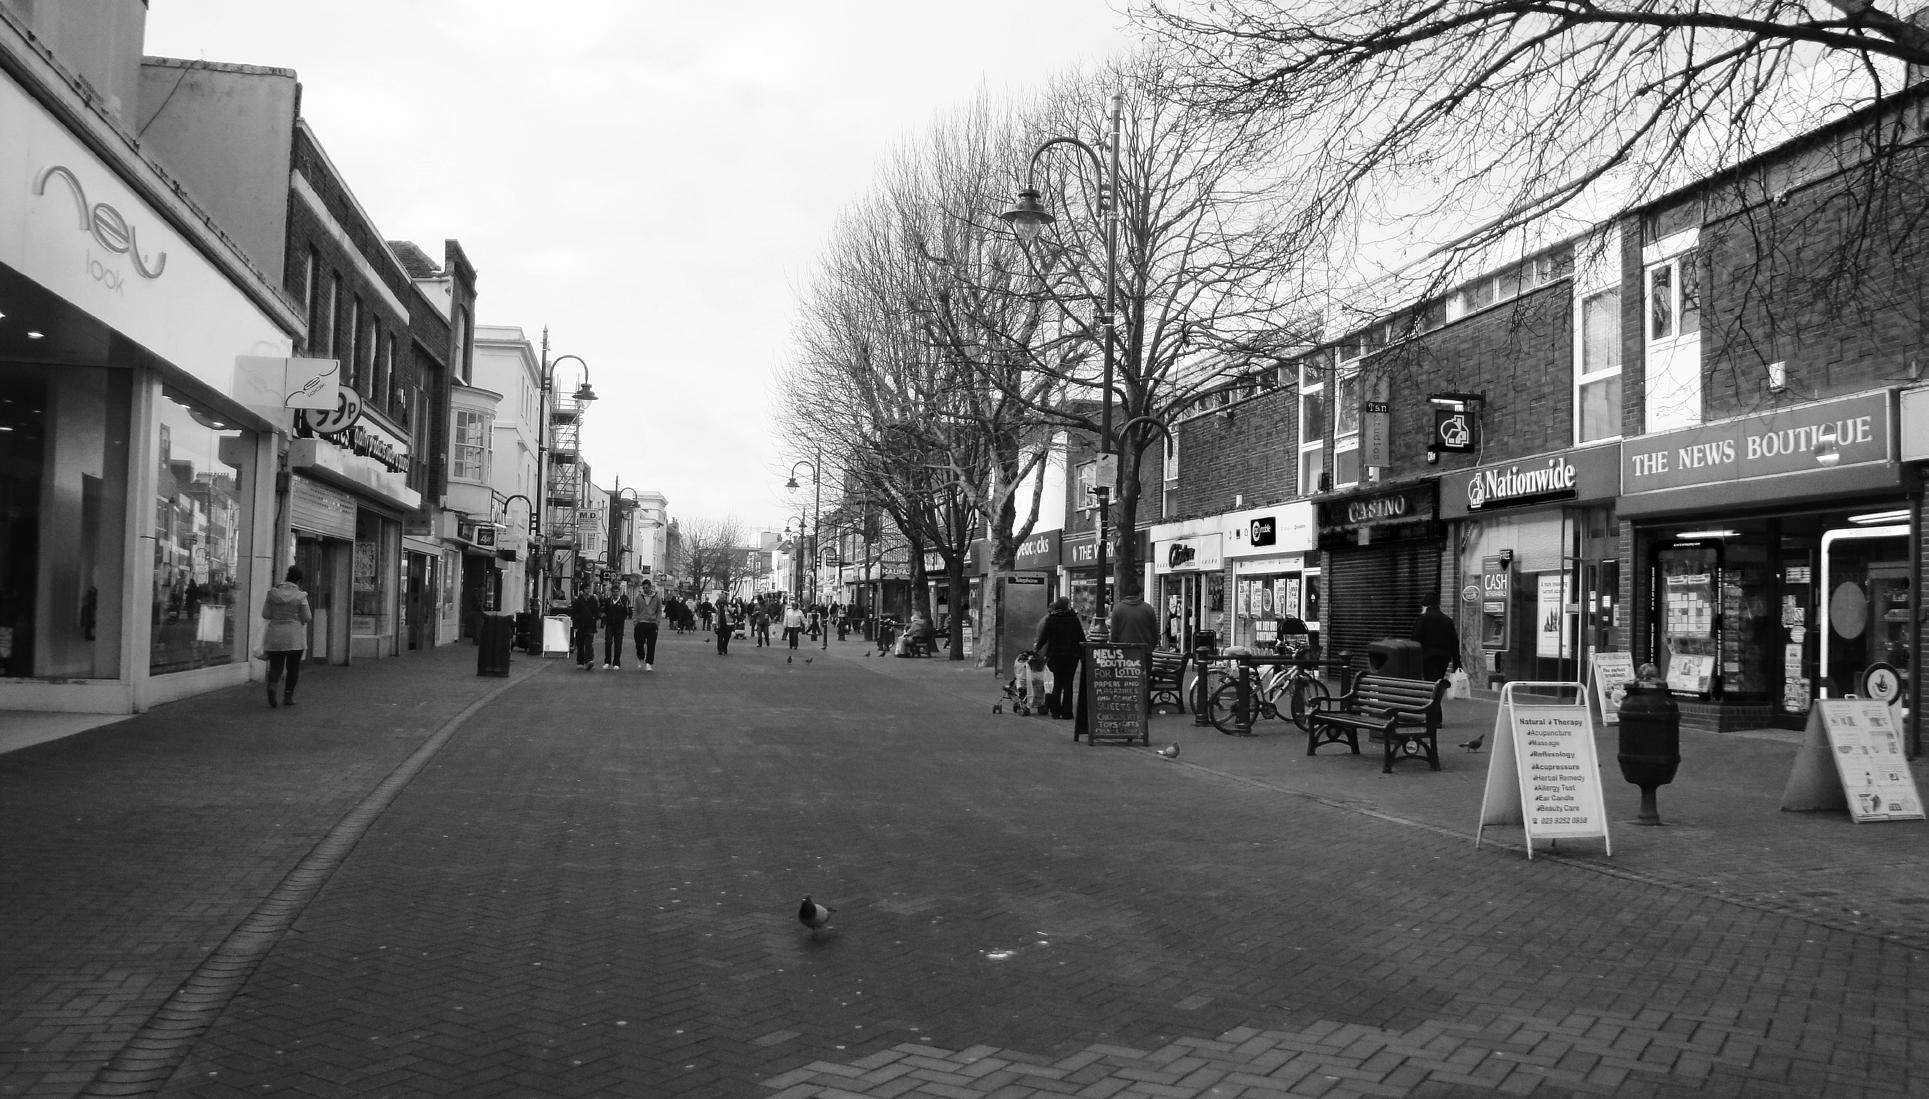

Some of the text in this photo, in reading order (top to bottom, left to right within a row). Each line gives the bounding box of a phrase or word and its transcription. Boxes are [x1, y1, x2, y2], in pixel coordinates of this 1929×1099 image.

[86, 247, 124, 296] look
[1368, 403, 1388, 413] Tan
[1632, 451, 1669, 476] THE
[1678, 440, 1735, 469] NEWS
[1485, 457, 1576, 499] Nationwide
[1348, 494, 1406, 523] CASINO
[1079, 545, 1092, 560] THE
[1484, 573, 1508, 591] CASH
[1093, 649, 1124, 659] NEWS
[1094, 668, 1141, 678] FOR LOTTO
[1554, 718, 1583, 727] Therapy
[1531, 729, 1572, 737] Acupuncture
[1533, 751, 1576, 759] Reflexology
[1559, 774, 1585, 782] Remedy
[1538, 784, 1560, 792] Allergy
[1541, 804, 1562, 812] Beauty
